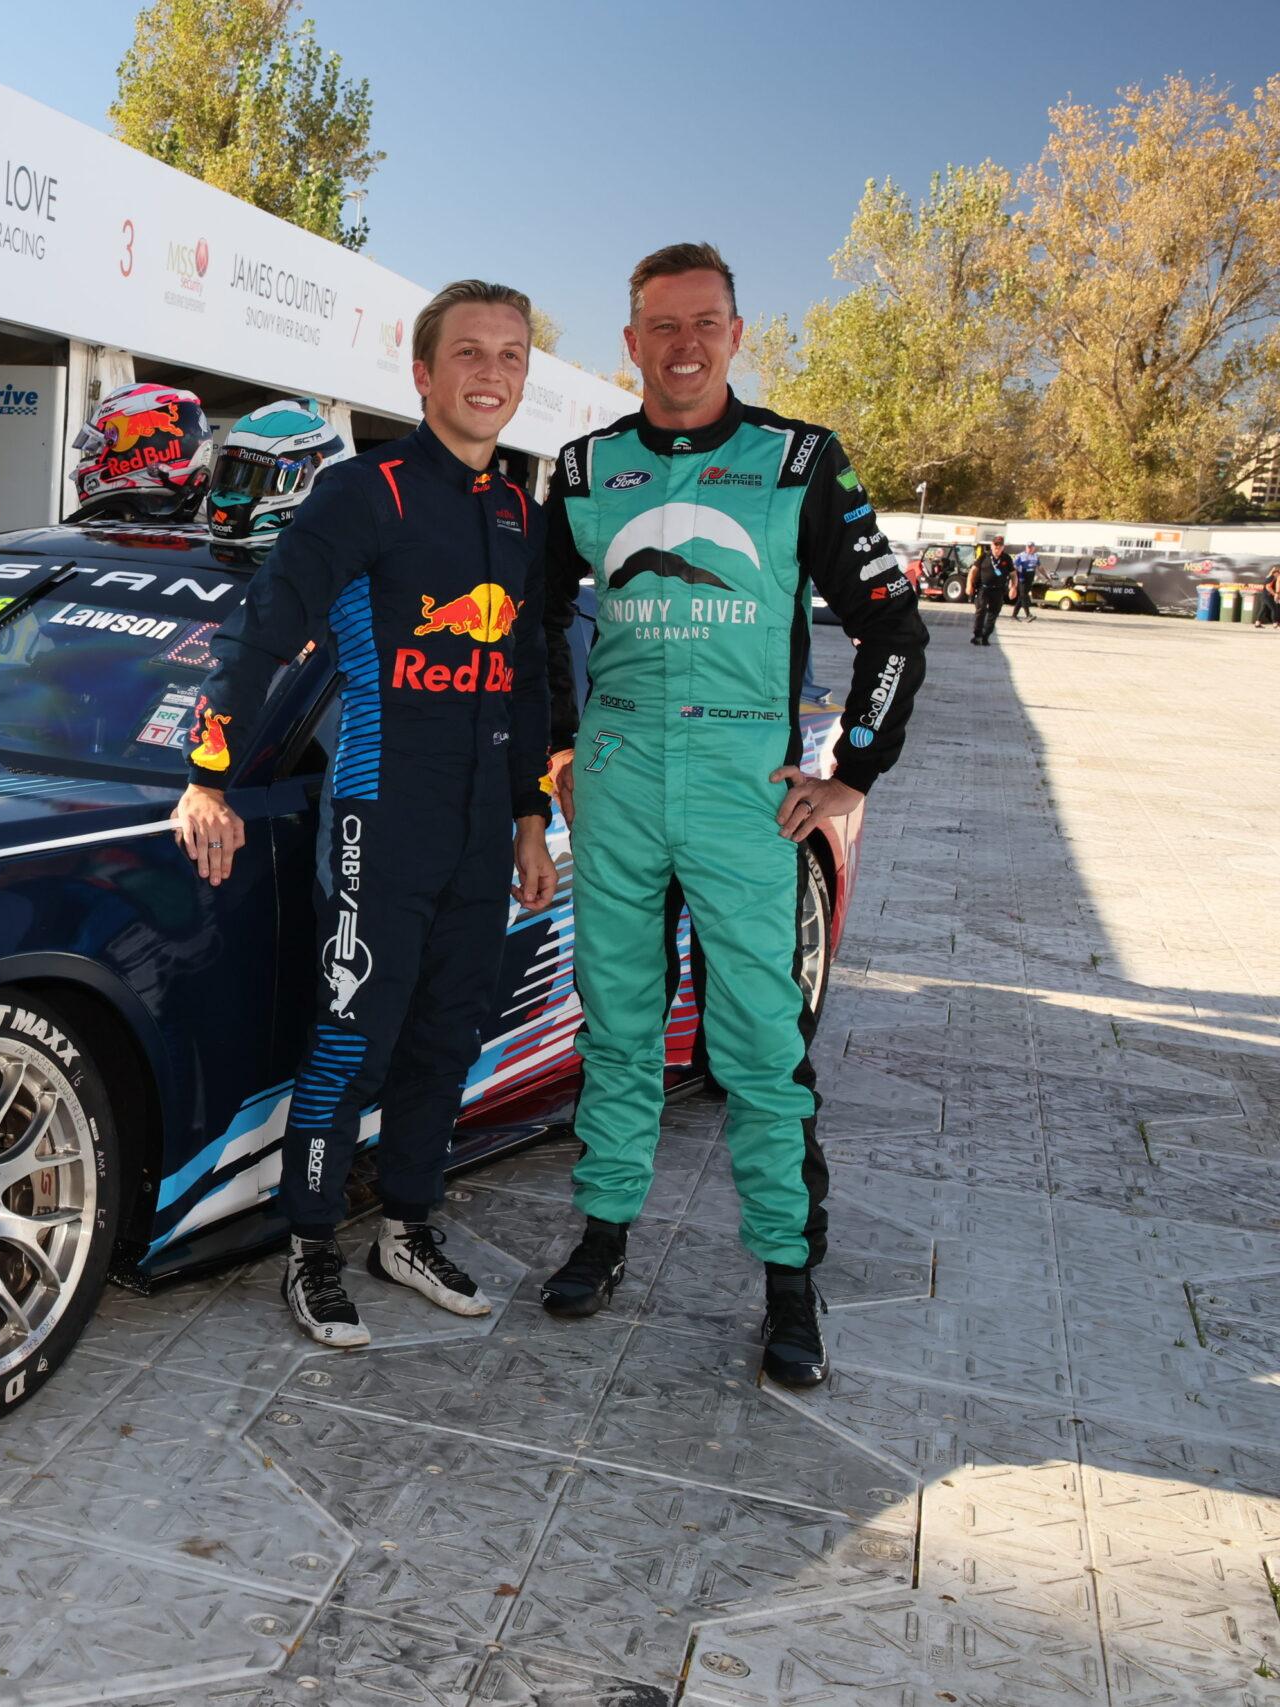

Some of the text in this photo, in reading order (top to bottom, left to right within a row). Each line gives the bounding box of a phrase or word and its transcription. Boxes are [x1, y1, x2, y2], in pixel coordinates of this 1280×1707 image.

[5, 160, 58, 222] LOVE
[120, 219, 134, 277] 3
[166, 240, 195, 278] MSS
[230, 253, 337, 321] JAMES COURTNEY
[245, 306, 320, 346] SNOWY RIVER RACING
[352, 308, 363, 348] 7
[107, 448, 144, 476] Red
[143, 439, 182, 465] Bull
[564, 446, 581, 487] sparco
[791, 433, 820, 475] sparco
[612, 472, 644, 489] Ford
[697, 479, 763, 487] INDUSTRIES
[48, 602, 179, 640] Lawson
[607, 598, 757, 624] SNOWY RIVER
[635, 626, 710, 640] CARAVANS
[392, 648, 482, 693] Red
[860, 654, 900, 727] CoolDrive
[600, 694, 636, 712] sparco
[708, 708, 784, 721] COURTNEY
[584, 731, 624, 772] 7
[10, 1007, 81, 1068] MAXX
[29, 1051, 88, 1132] RACER INDUSTRIES
[70, 1069, 84, 1087] 16
[96, 1150, 106, 1178] AMF
[307, 1137, 326, 1193] sparco
